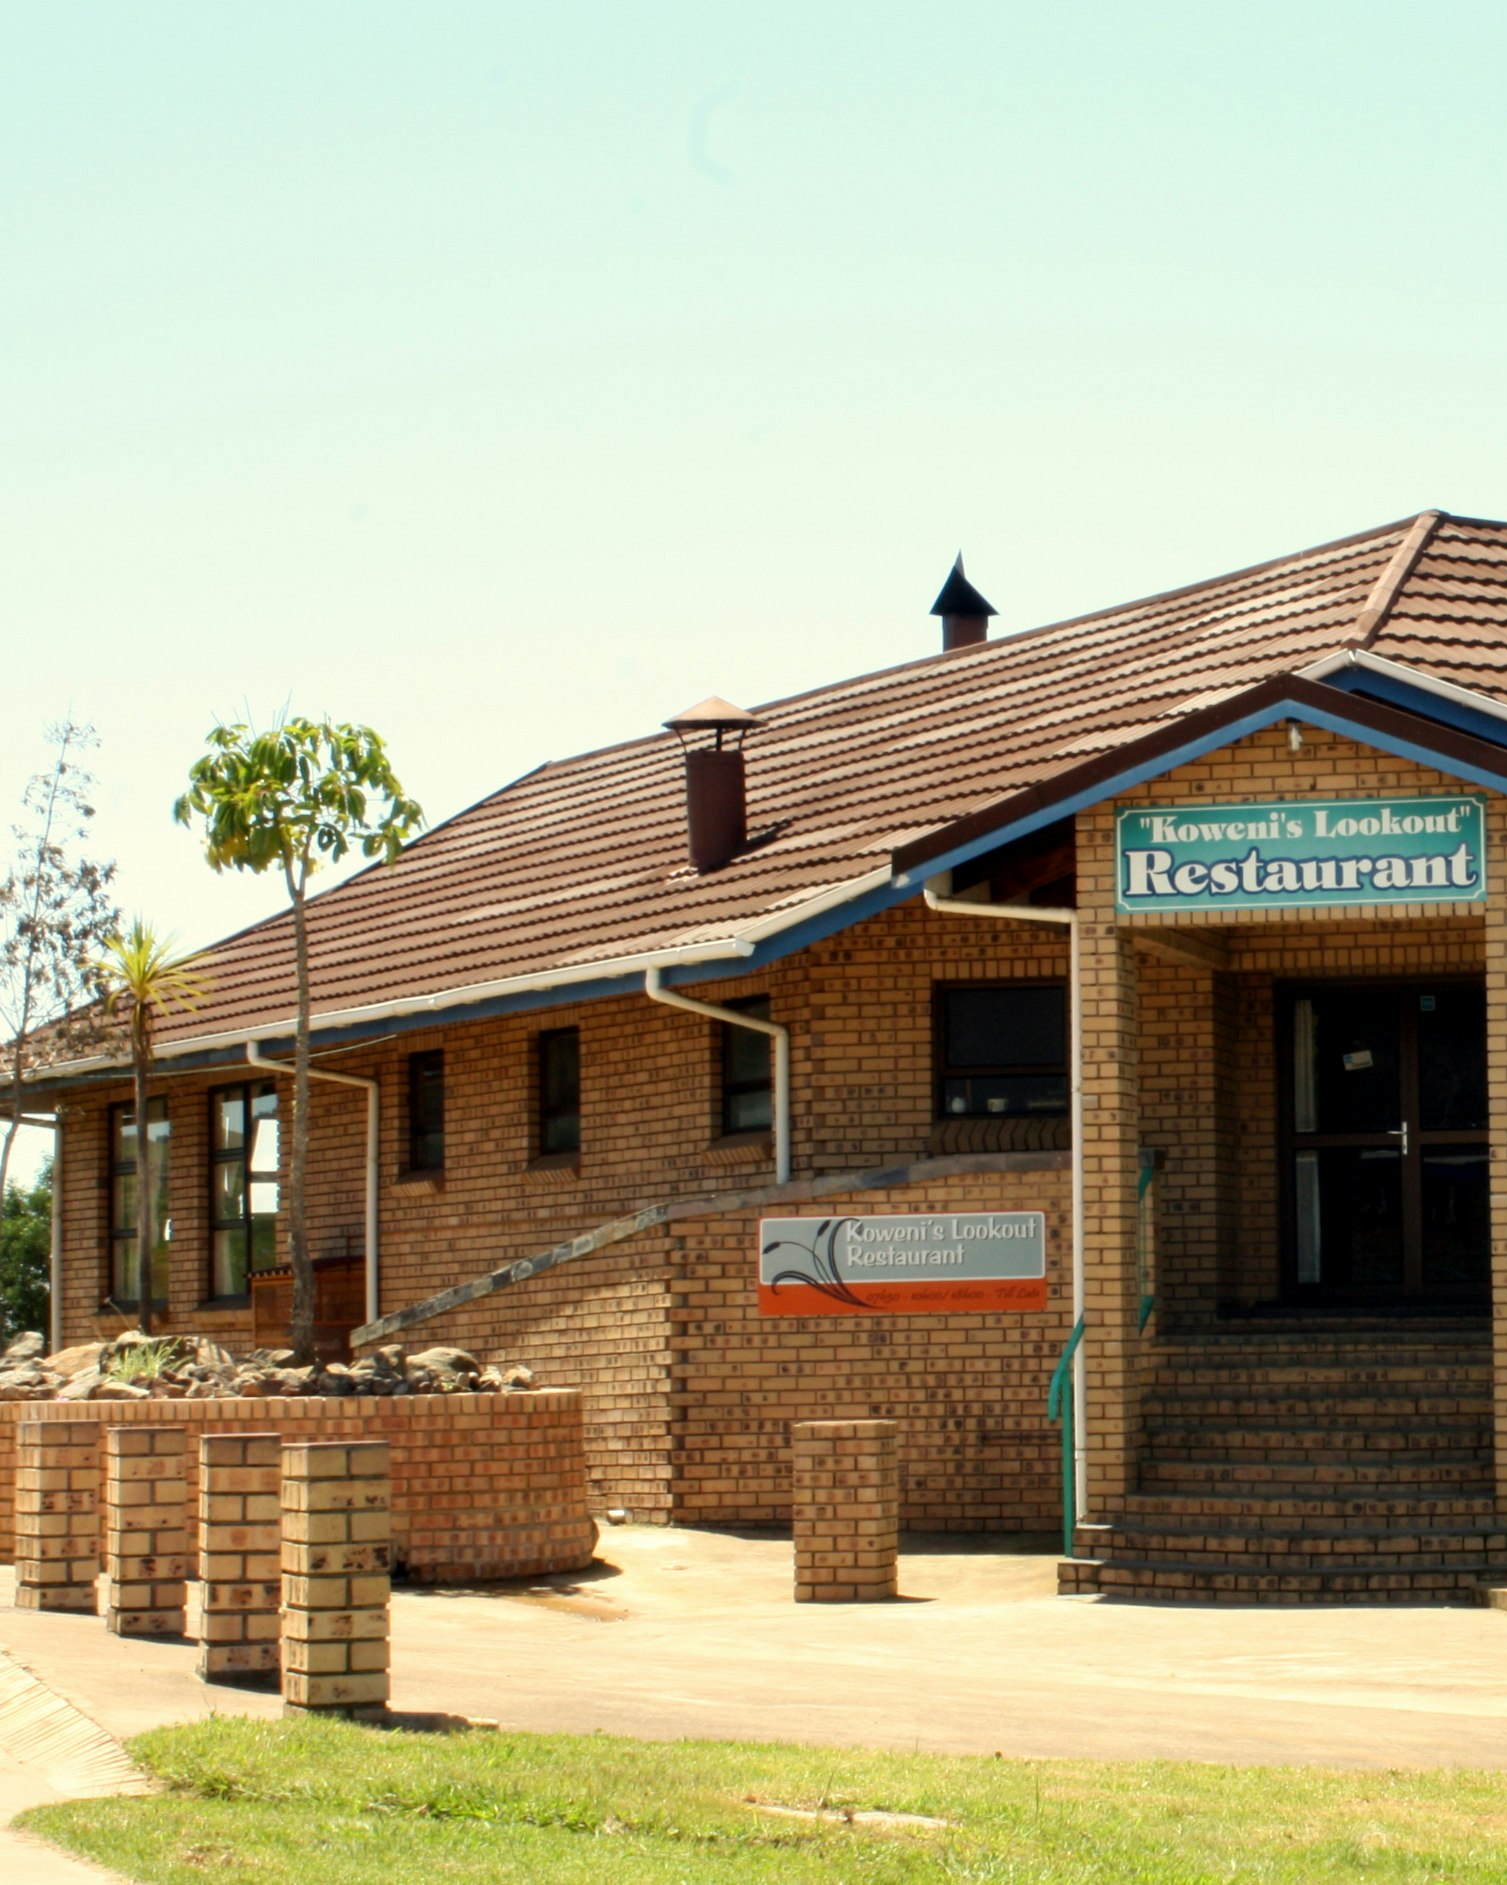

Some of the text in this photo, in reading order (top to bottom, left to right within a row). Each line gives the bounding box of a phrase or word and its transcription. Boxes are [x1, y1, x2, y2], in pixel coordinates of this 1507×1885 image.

[1140, 805, 1471, 844] "Koweni's Lookout"
[1124, 843, 1477, 895] Restaurant
[846, 1217, 1037, 1242] Koweni's Lookout
[847, 1244, 965, 1267] Restaurant
